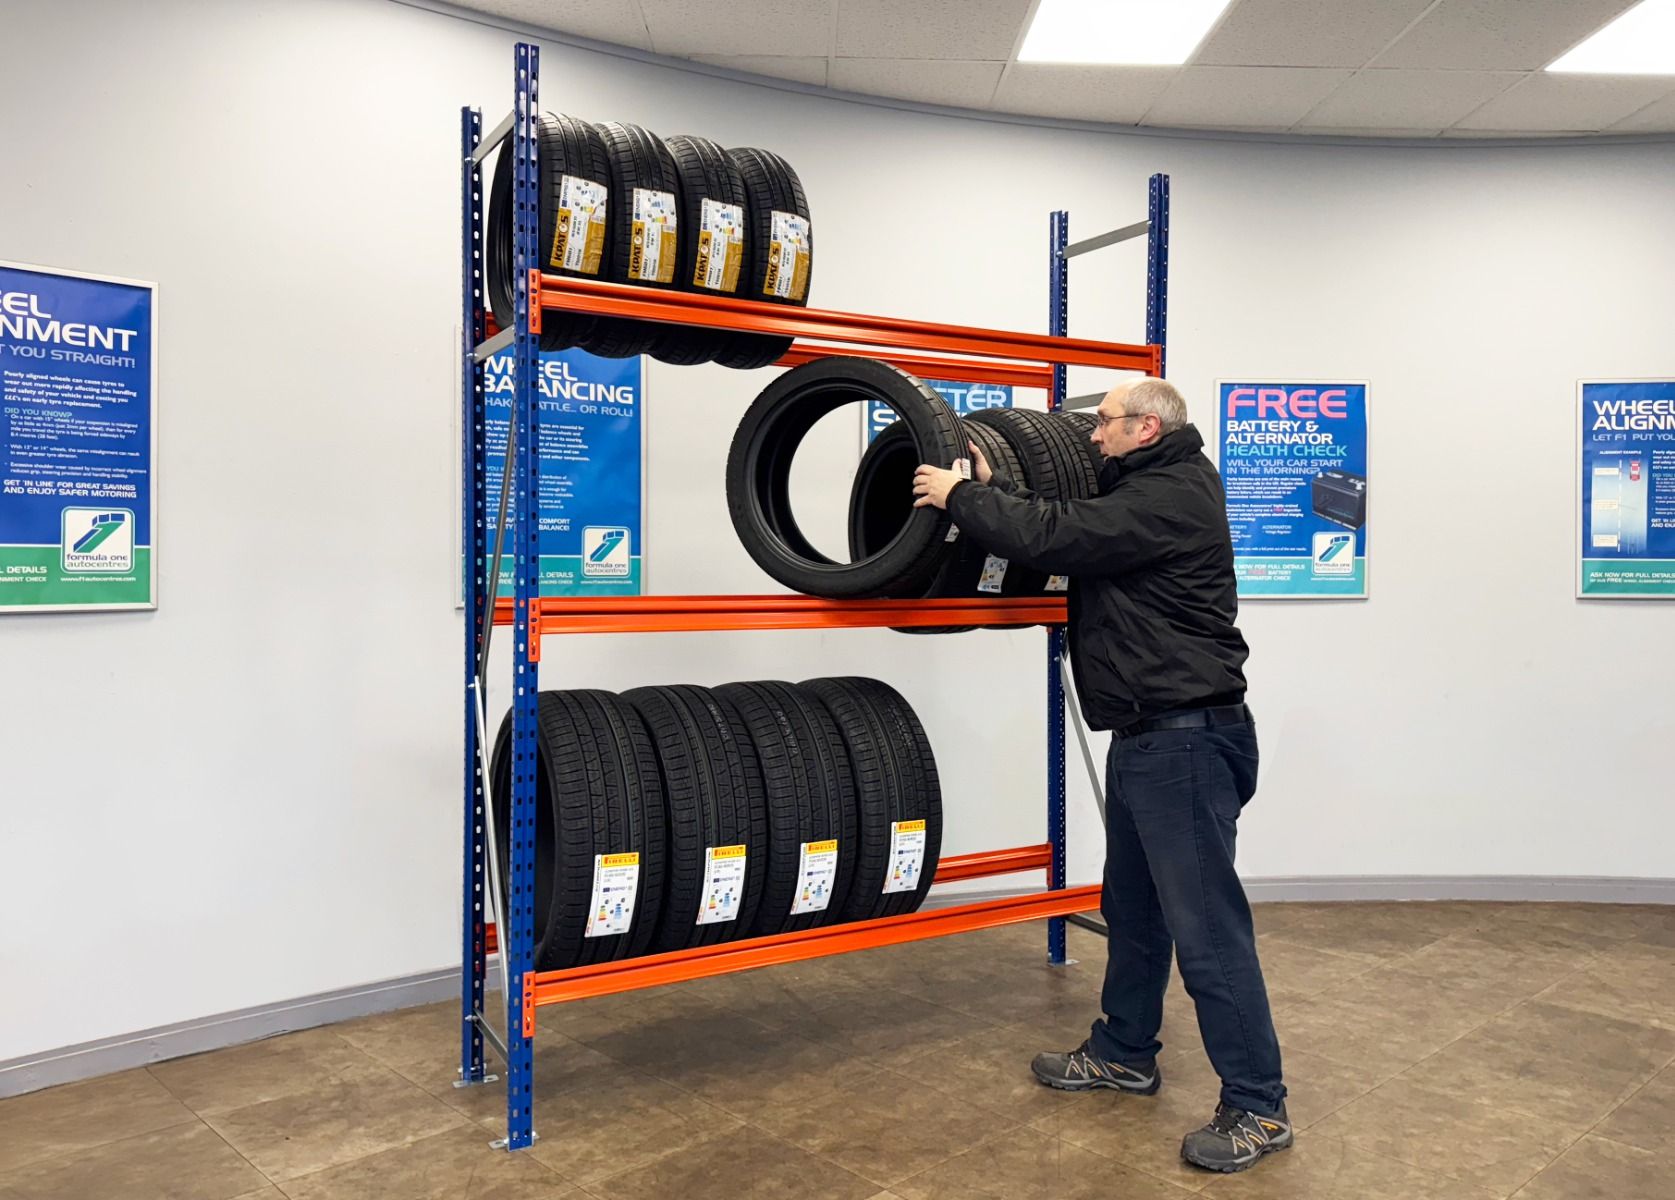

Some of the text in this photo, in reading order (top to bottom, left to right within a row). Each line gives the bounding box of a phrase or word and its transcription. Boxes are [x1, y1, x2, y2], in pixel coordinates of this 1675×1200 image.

[0, 290, 52, 319] EL
[0, 314, 137, 352] NMENT
[9, 344, 46, 358] YOU
[50, 349, 136, 369] STRAIGHT!
[484, 355, 578, 381] WEL
[484, 373, 634, 405] BAANCING
[1227, 388, 1347, 418] FREE
[4, 407, 72, 418] DID YOU KNOW?
[579, 404, 598, 414] OR
[601, 406, 633, 417] ROLL!
[1226, 420, 1319, 433] BATTERY &
[1225, 432, 1334, 445] ALTERNATOR
[1592, 433, 1613, 442] LET
[1614, 433, 1627, 441] F1
[1632, 433, 1654, 441] PUT
[1226, 445, 1348, 457] HEALTH CHECK
[1226, 458, 1344, 468] WILL YOUR CAR START
[1226, 467, 1321, 476] IN THE MORNING?
[3, 486, 137, 498] AND ENJOY SAFER MOTORING
[57, 481, 74, 489] FOR
[75, 482, 101, 490] GREAT
[102, 483, 136, 491] SAVINGS
[66, 553, 108, 561] formula
[7, 566, 47, 574] DETAILS
